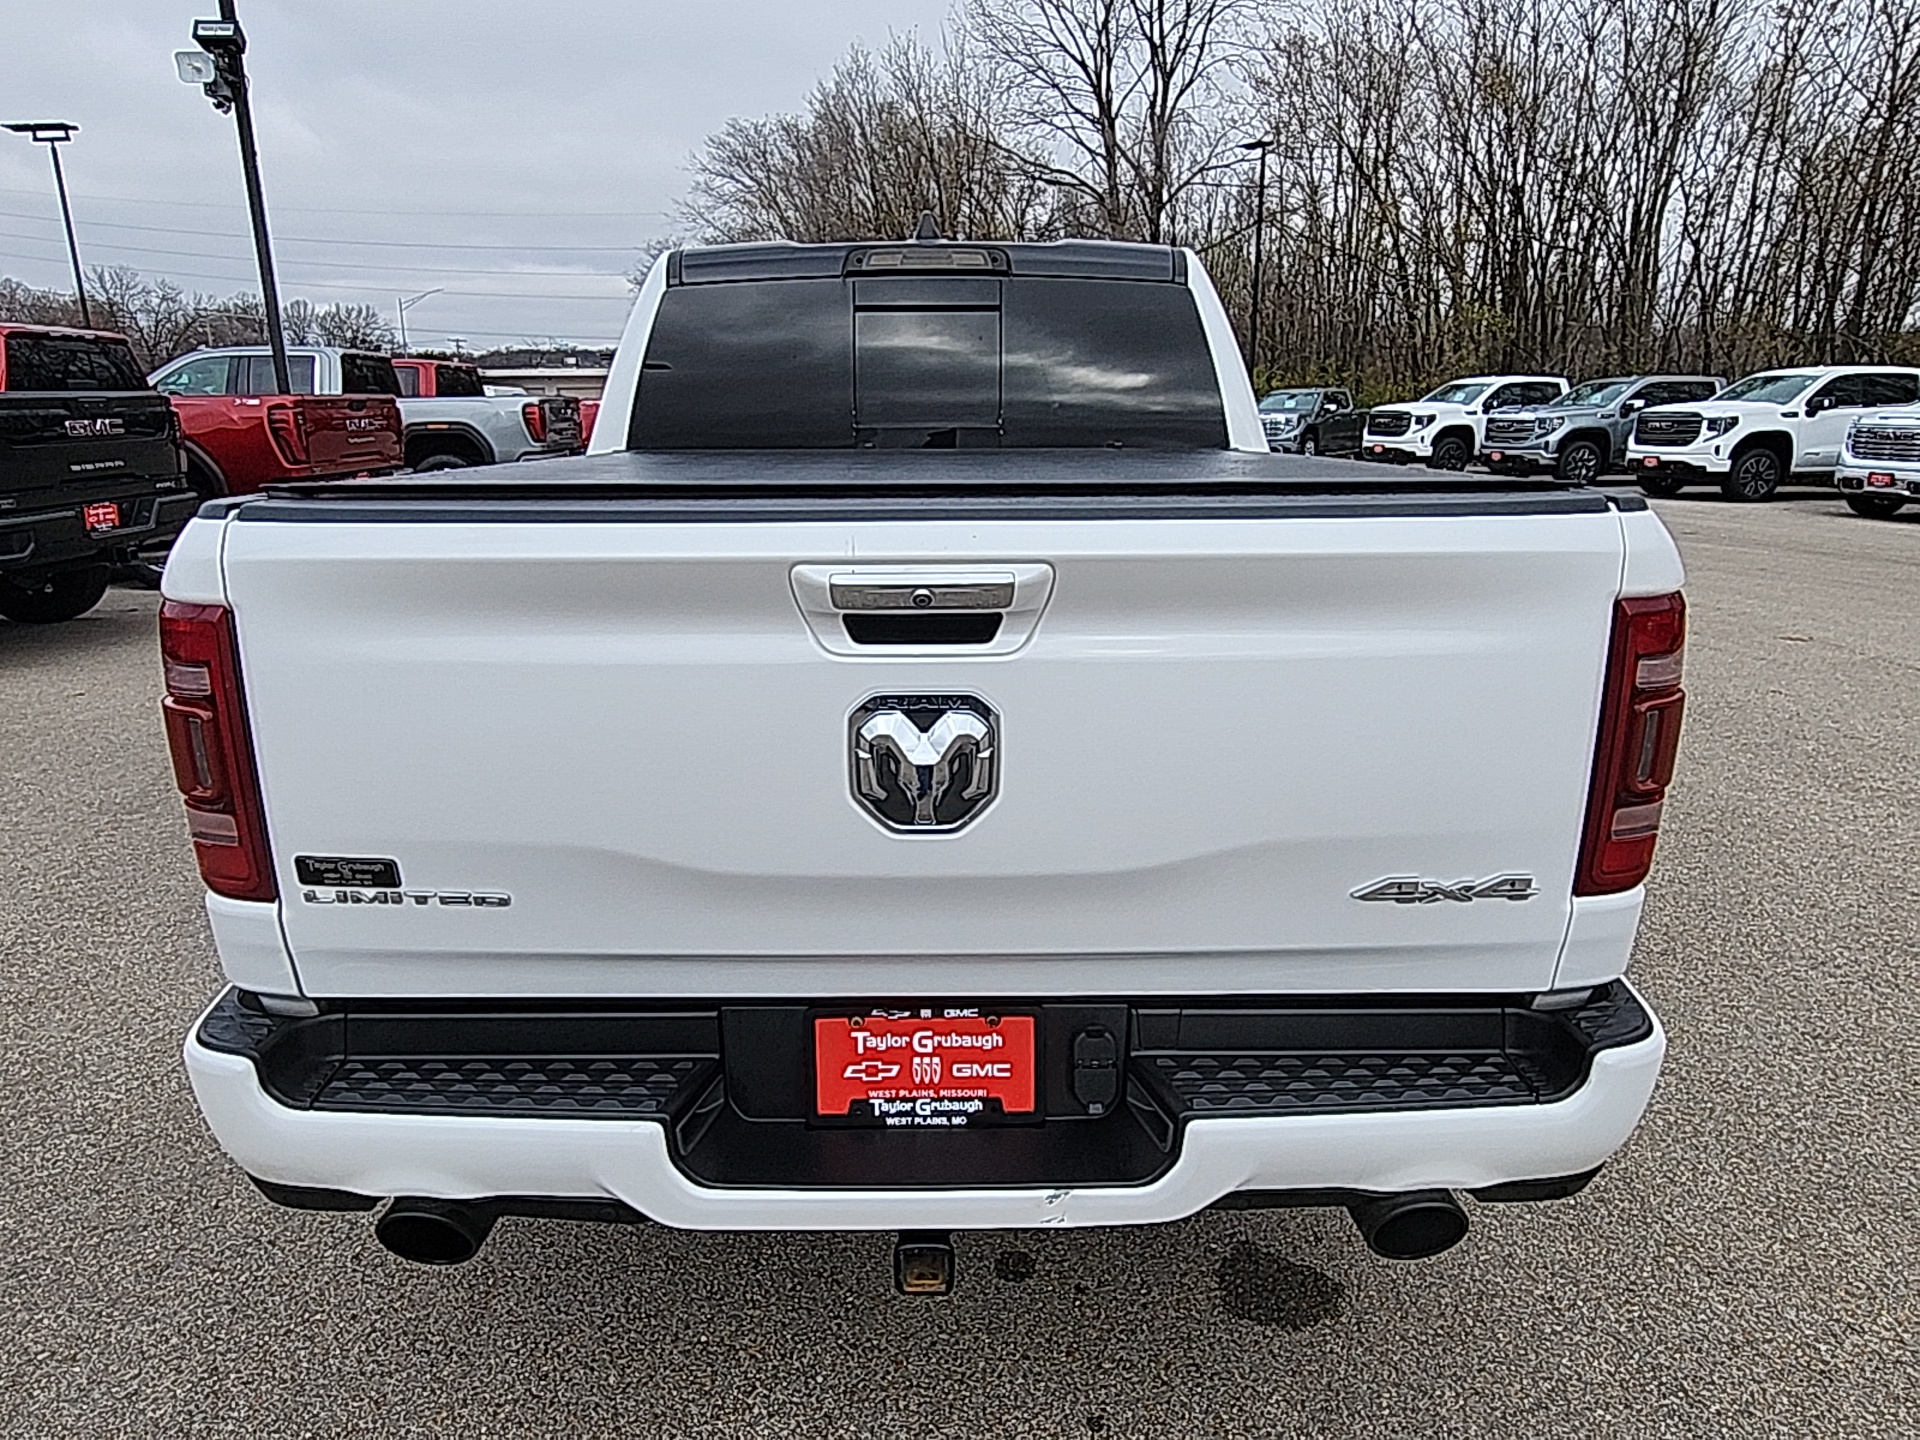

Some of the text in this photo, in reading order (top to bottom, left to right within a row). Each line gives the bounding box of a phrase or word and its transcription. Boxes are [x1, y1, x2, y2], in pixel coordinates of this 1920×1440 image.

[65, 418, 125, 437] GMC
[878, 696, 970, 710] RAM
[302, 889, 513, 908] LIMITED
[944, 1008, 979, 1018] GMC
[850, 1030, 1003, 1055] Taylor Grubaugh
[952, 1063, 1012, 1078] GMC
[868, 1089, 988, 1098] WEST PLAINS, MISSOURI
[869, 1098, 984, 1117] Taylor Grubaugh
[885, 1116, 968, 1126] WEST PLAINS, MO
